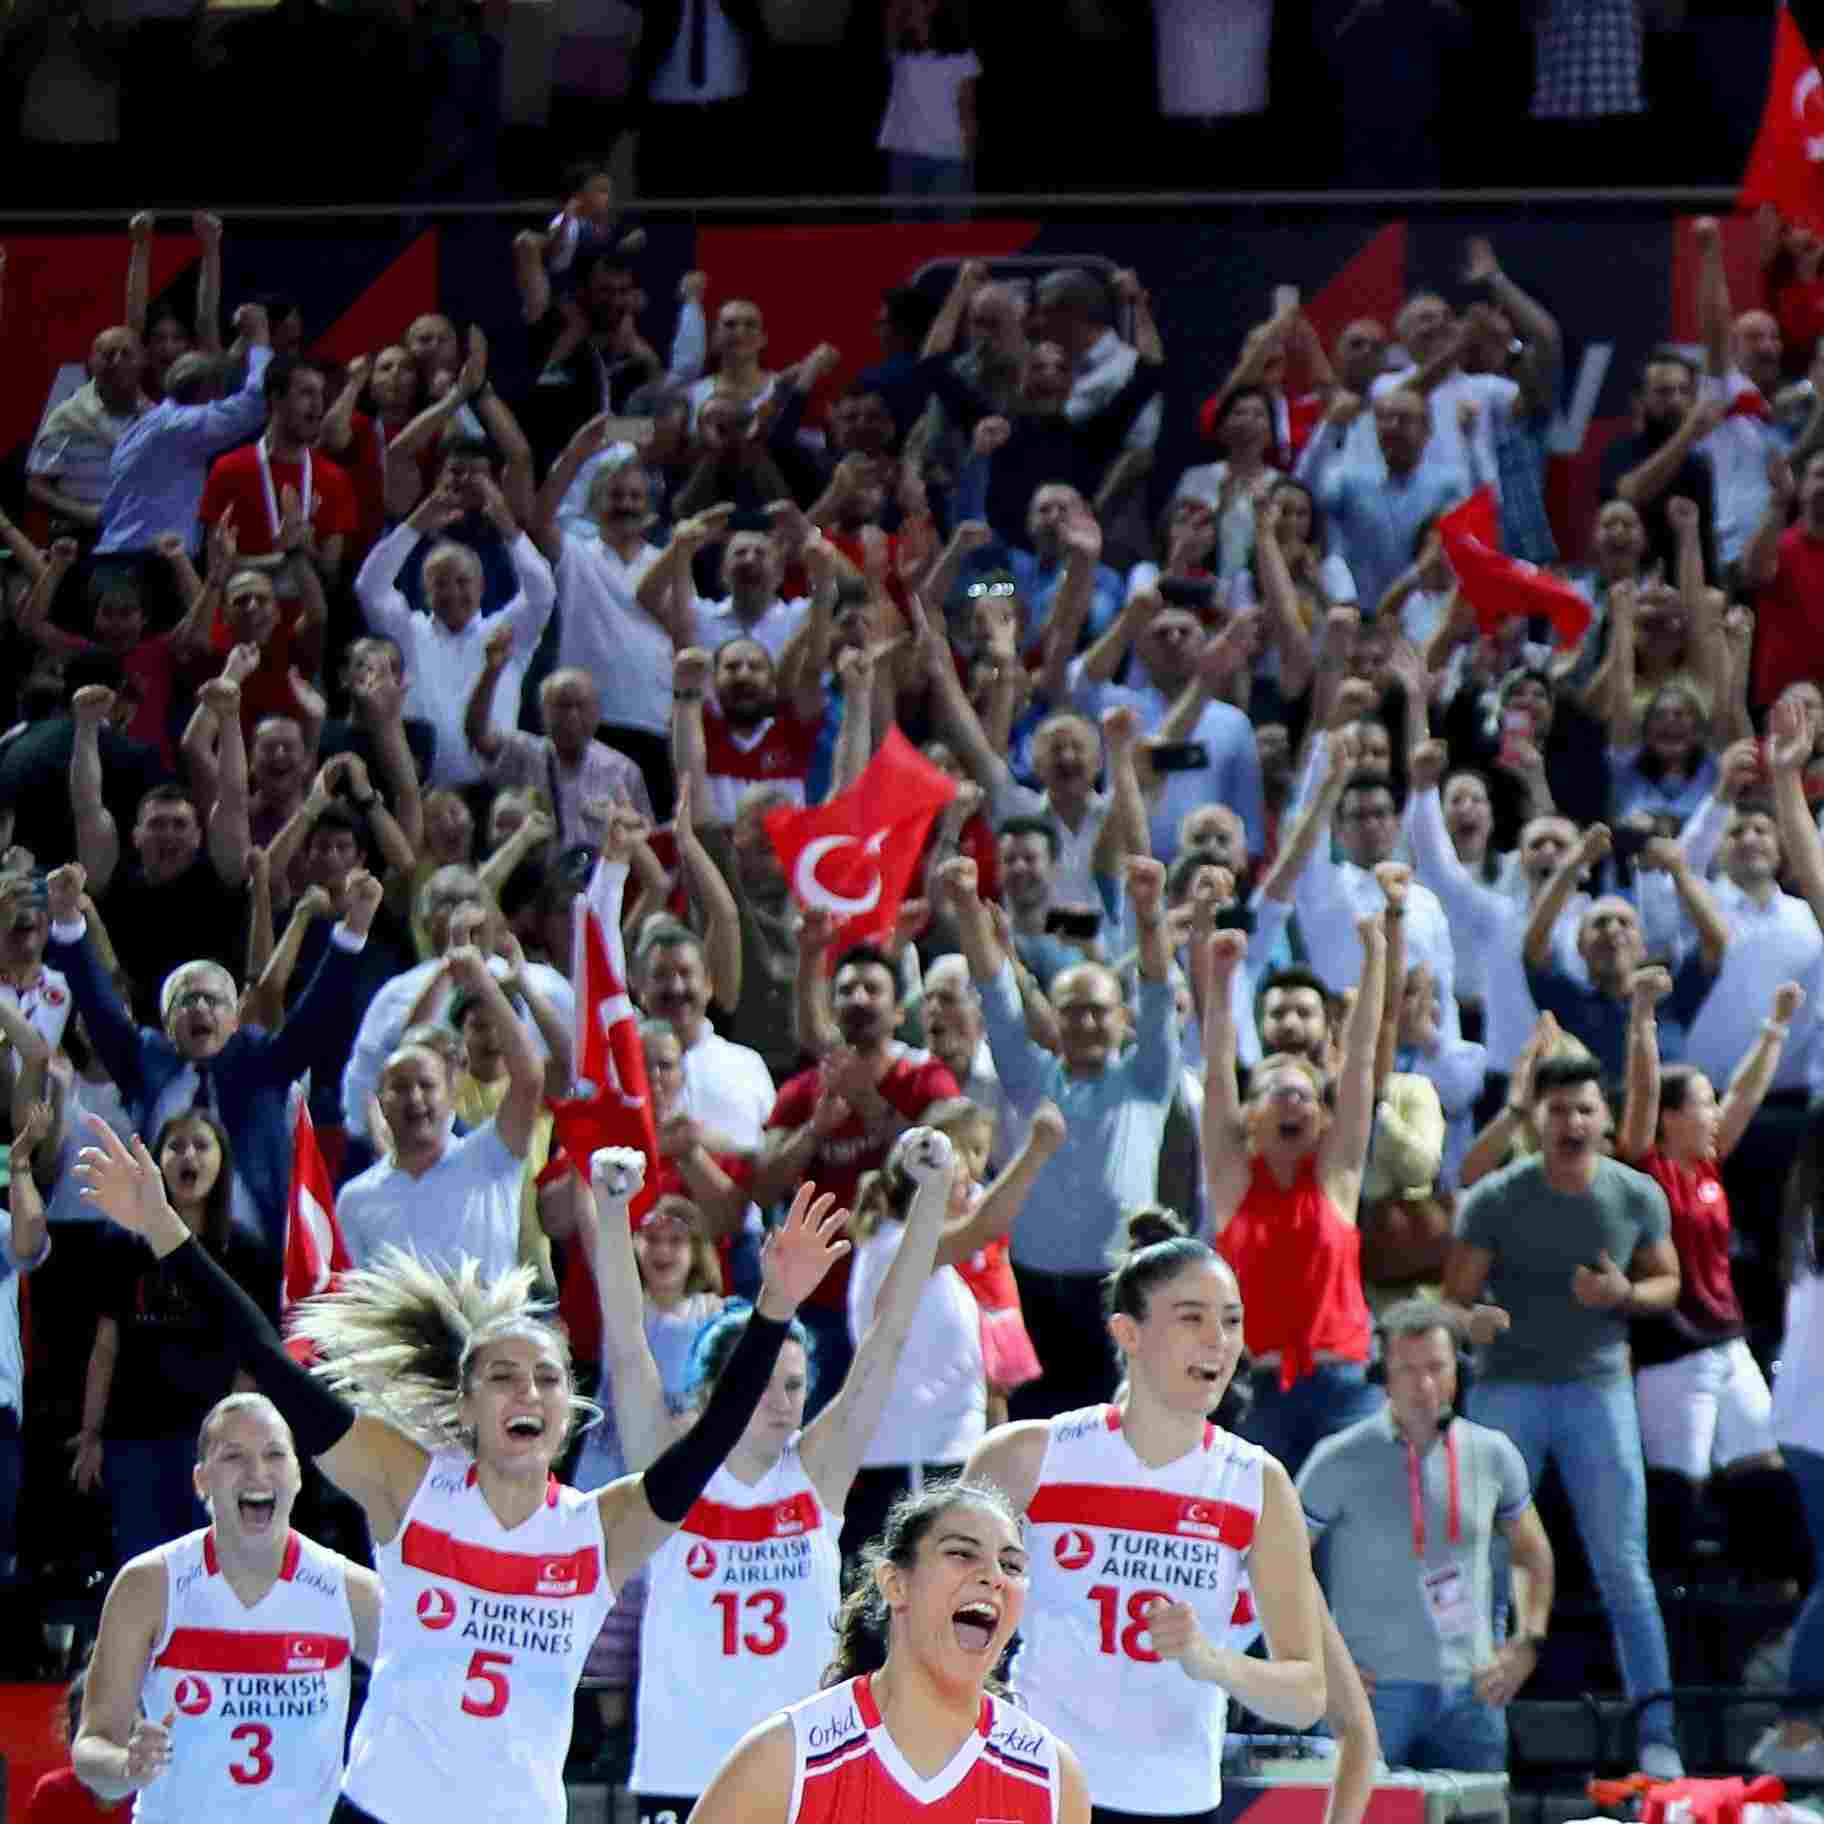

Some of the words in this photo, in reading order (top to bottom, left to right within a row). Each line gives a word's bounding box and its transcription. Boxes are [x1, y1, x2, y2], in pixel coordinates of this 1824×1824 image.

[725, 1539, 810, 1562] TURKISH
[1107, 1532, 1220, 1565] TURKISH
[722, 1561, 811, 1584] AIRLINE
[1101, 1558, 1219, 1590] AIRLINES
[468, 1597, 574, 1628] TURKISH
[711, 1588, 790, 1658] 13
[1087, 1584, 1176, 1664] 18
[462, 1620, 573, 1654] AIRLINES
[221, 1676, 328, 1698] TURKISH
[460, 1647, 513, 1720] 5
[220, 1695, 328, 1719] AIRLINES
[808, 1706, 856, 1748] Orkid
[228, 1722, 275, 1788] 3
